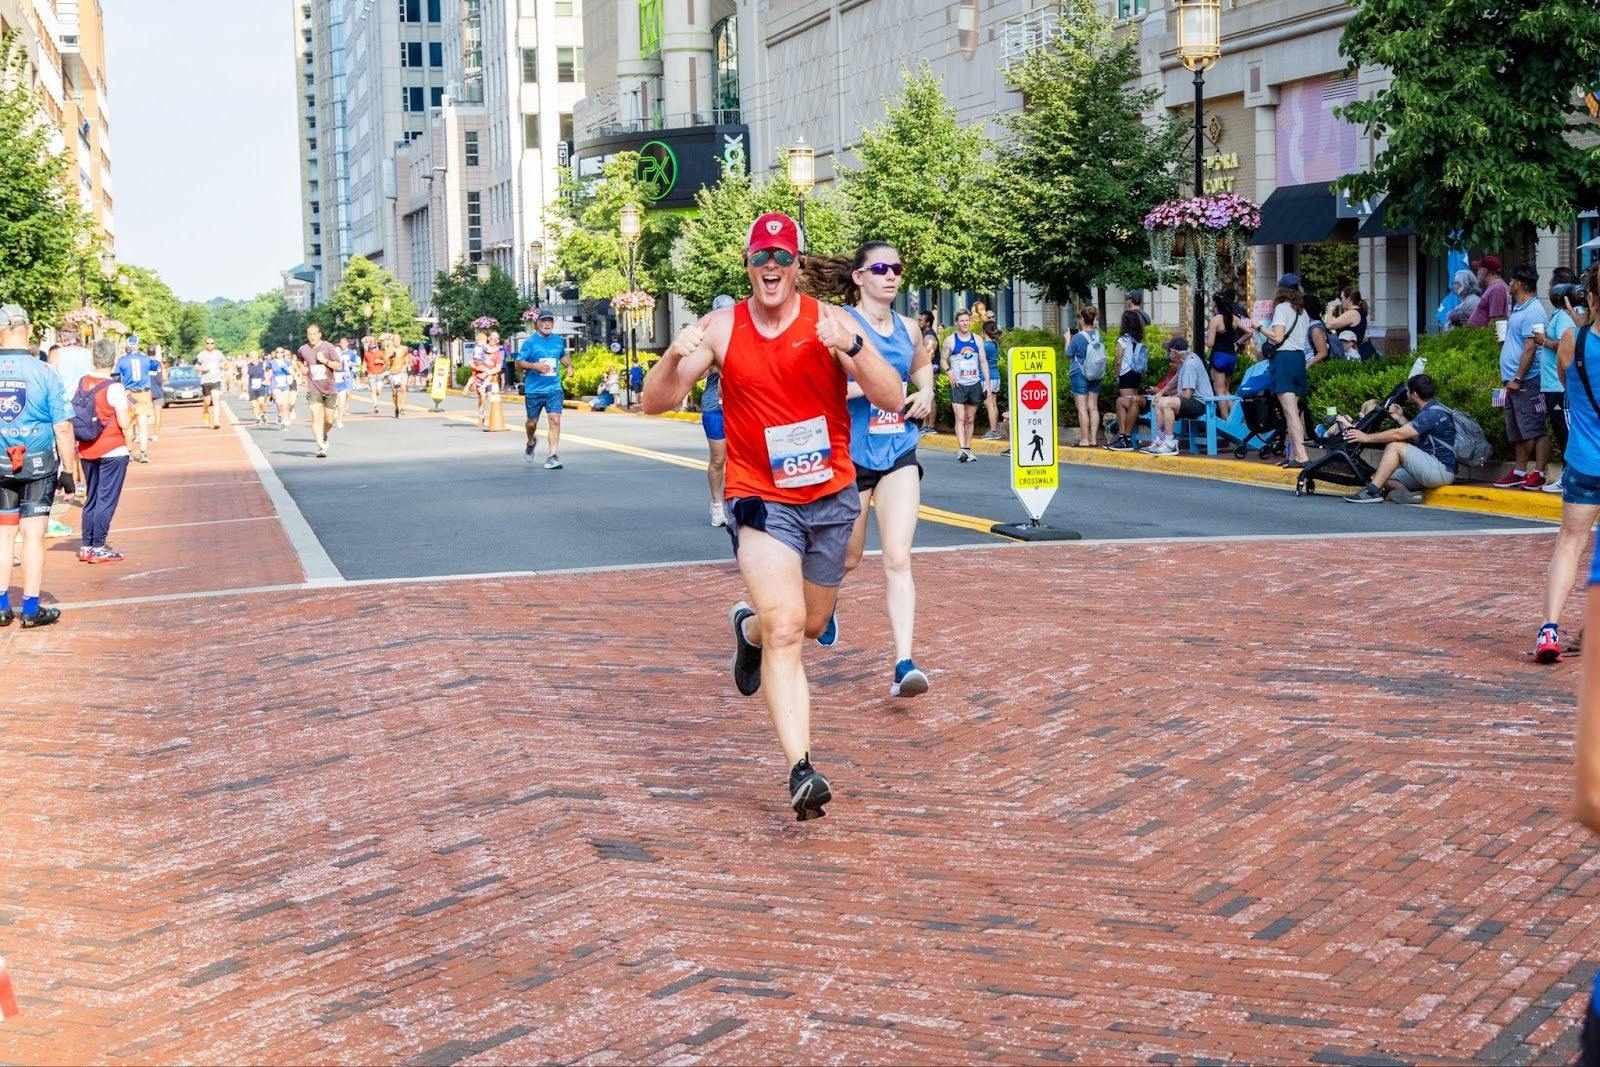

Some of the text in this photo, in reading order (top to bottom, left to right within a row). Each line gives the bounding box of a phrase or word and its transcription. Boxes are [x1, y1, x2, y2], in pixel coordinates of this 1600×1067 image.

[1020, 350, 1048, 360] STATE
[1024, 361, 1043, 371] LAW
[1022, 389, 1047, 401] STOP
[1027, 418, 1042, 426] FOR
[783, 451, 824, 476] 652
[1027, 468, 1047, 476] WITHIN
[1018, 477, 1054, 485] CROSSWALK
